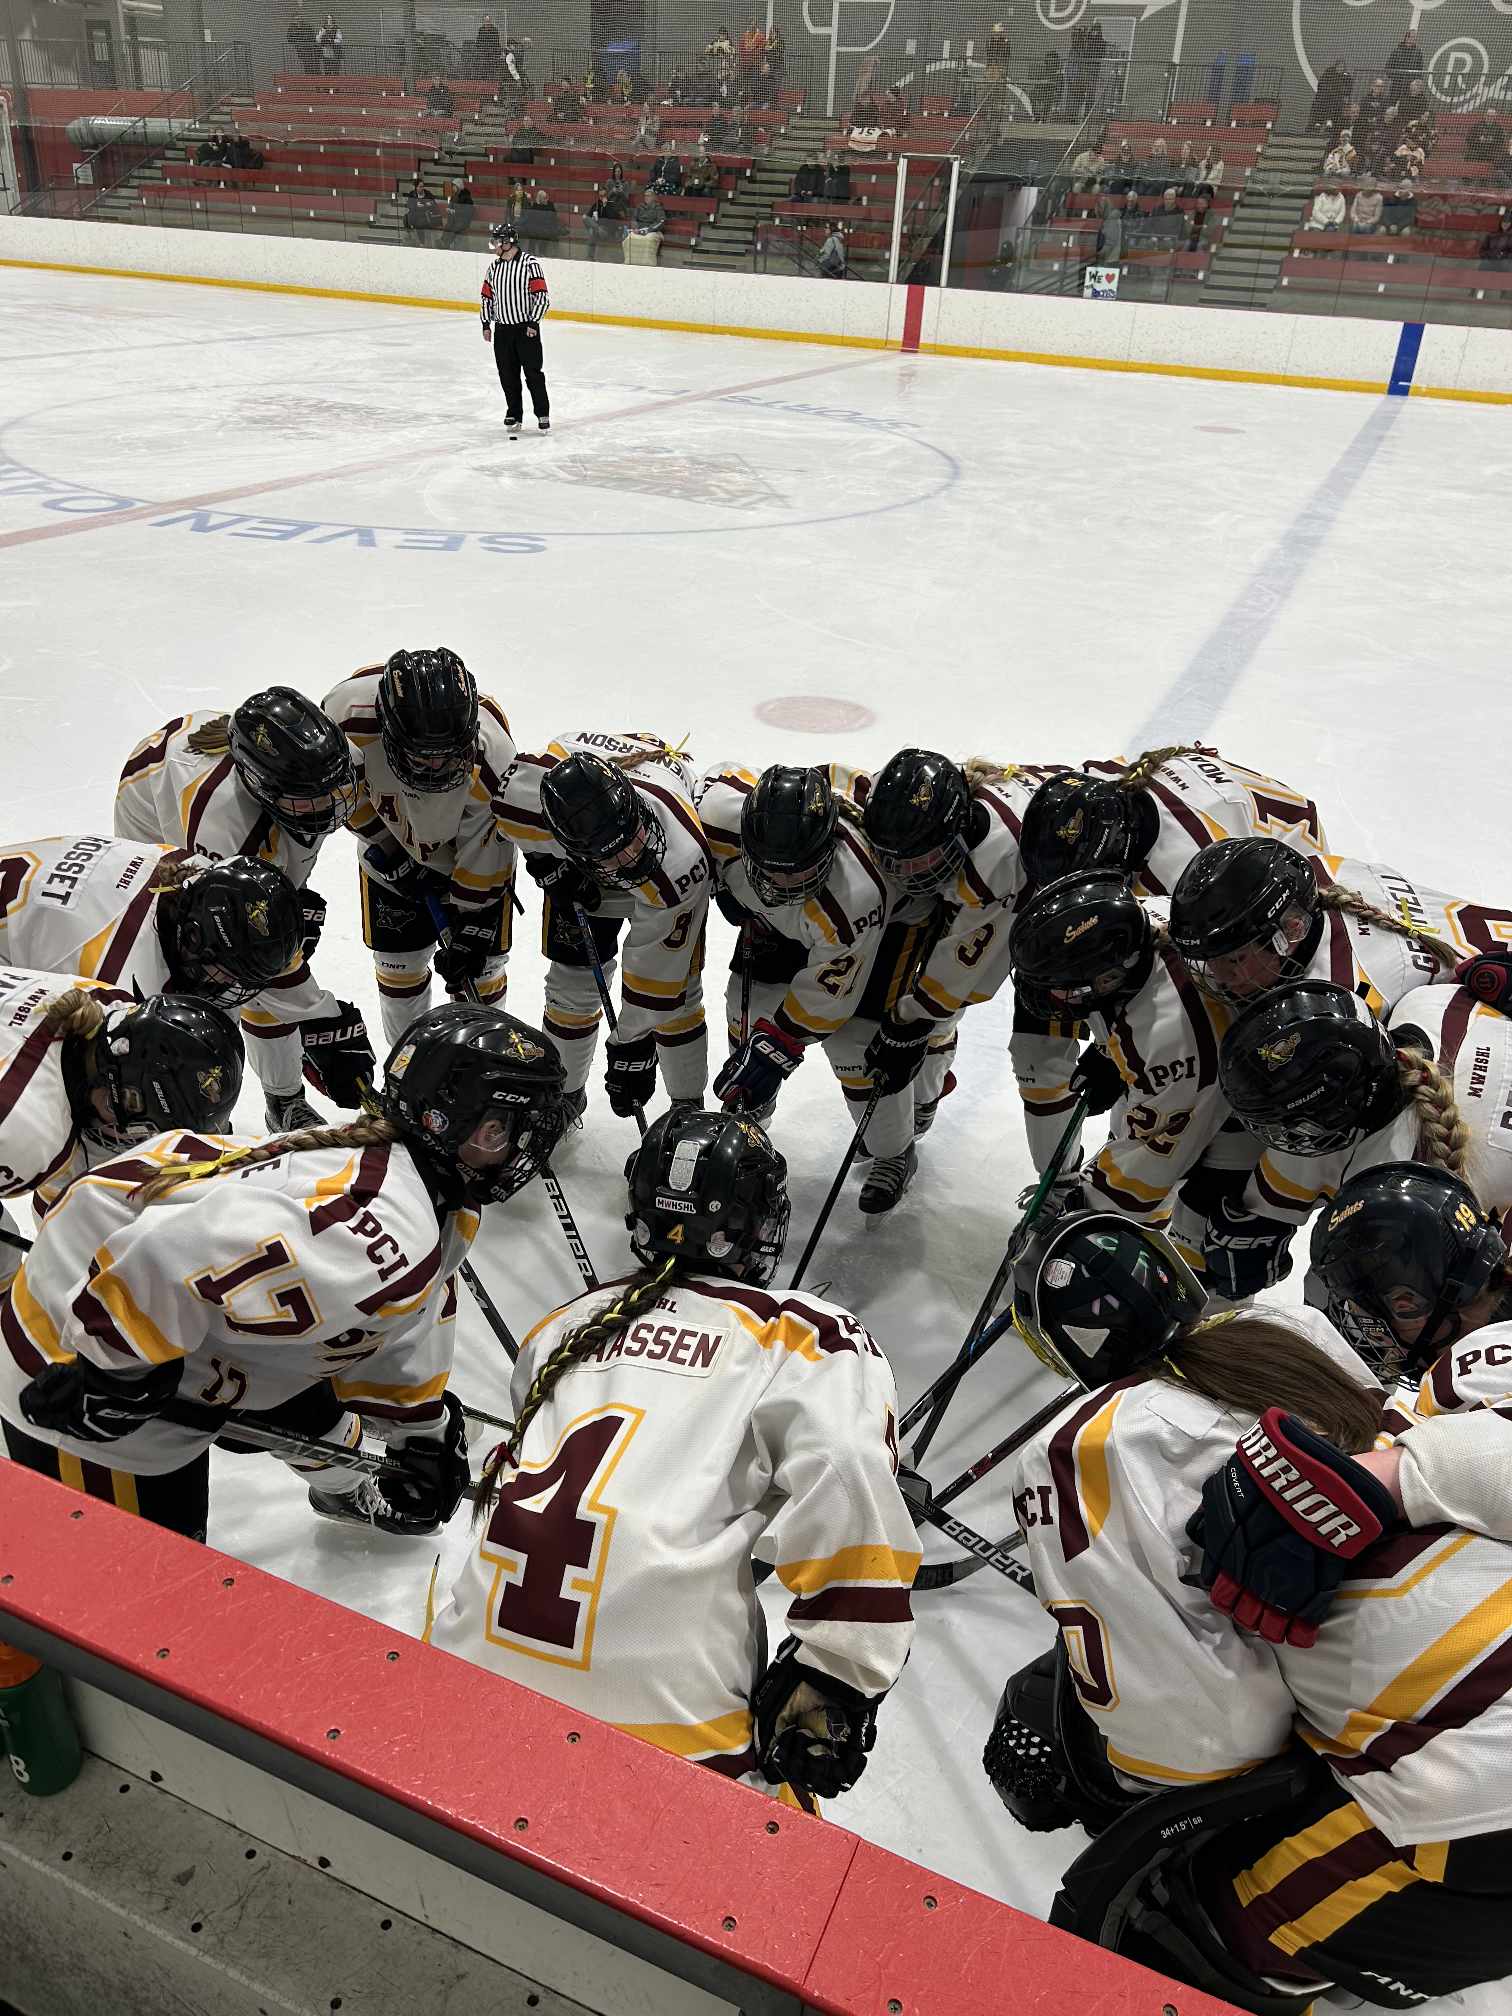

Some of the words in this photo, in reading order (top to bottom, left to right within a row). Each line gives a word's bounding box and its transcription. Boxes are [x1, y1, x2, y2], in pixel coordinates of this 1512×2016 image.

[149, 510, 548, 555] SEVEN
[675, 857, 708, 895] PCI
[1149, 1055, 1196, 1088] PCI
[1467, 1046, 1491, 1099] MWHSHL
[492, 1090, 531, 1104] CCM
[657, 1198, 696, 1214] MWHSHL
[1455, 1203, 1477, 1232] 19
[347, 1210, 409, 1283] PCI
[667, 1223, 685, 1244] 4
[184, 1233, 324, 1342] 17
[1230, 1467, 1245, 1499] COVERT
[481, 1403, 646, 1672] 4
[941, 1518, 1033, 1583] BAUER
